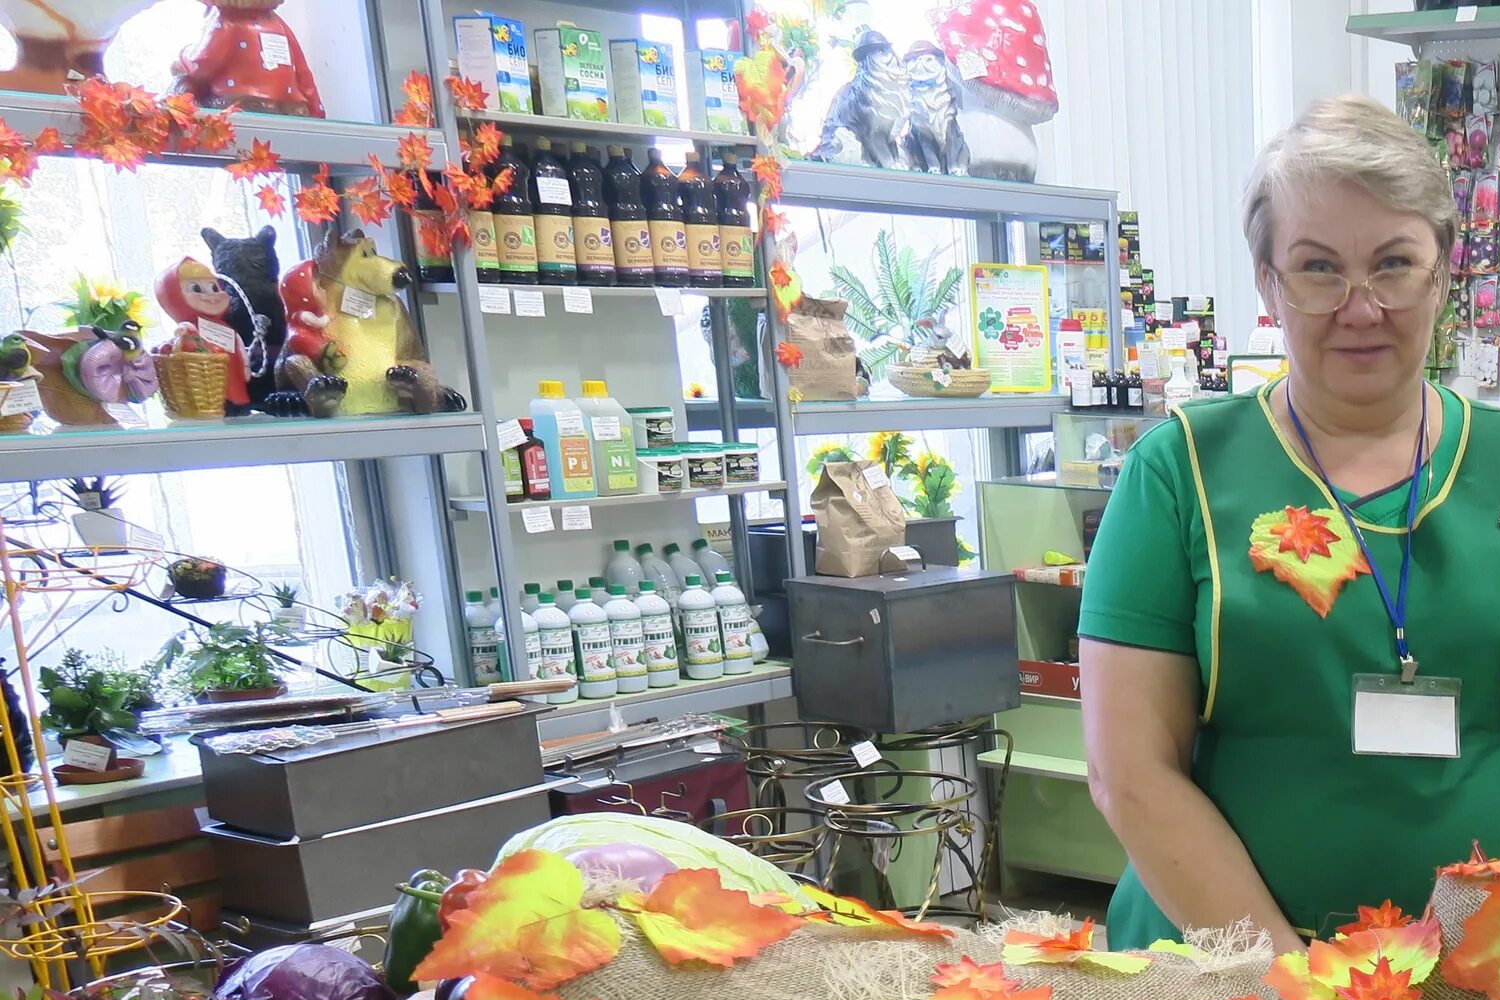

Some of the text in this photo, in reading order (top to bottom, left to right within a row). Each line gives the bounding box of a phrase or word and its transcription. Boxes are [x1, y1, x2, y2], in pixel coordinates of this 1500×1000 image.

[507, 43, 526, 58] БИО
[579, 68, 605, 80] СОСНА
[568, 457, 578, 470] P
[611, 455, 623, 467] N
[1019, 673, 1040, 684] -ВИР
